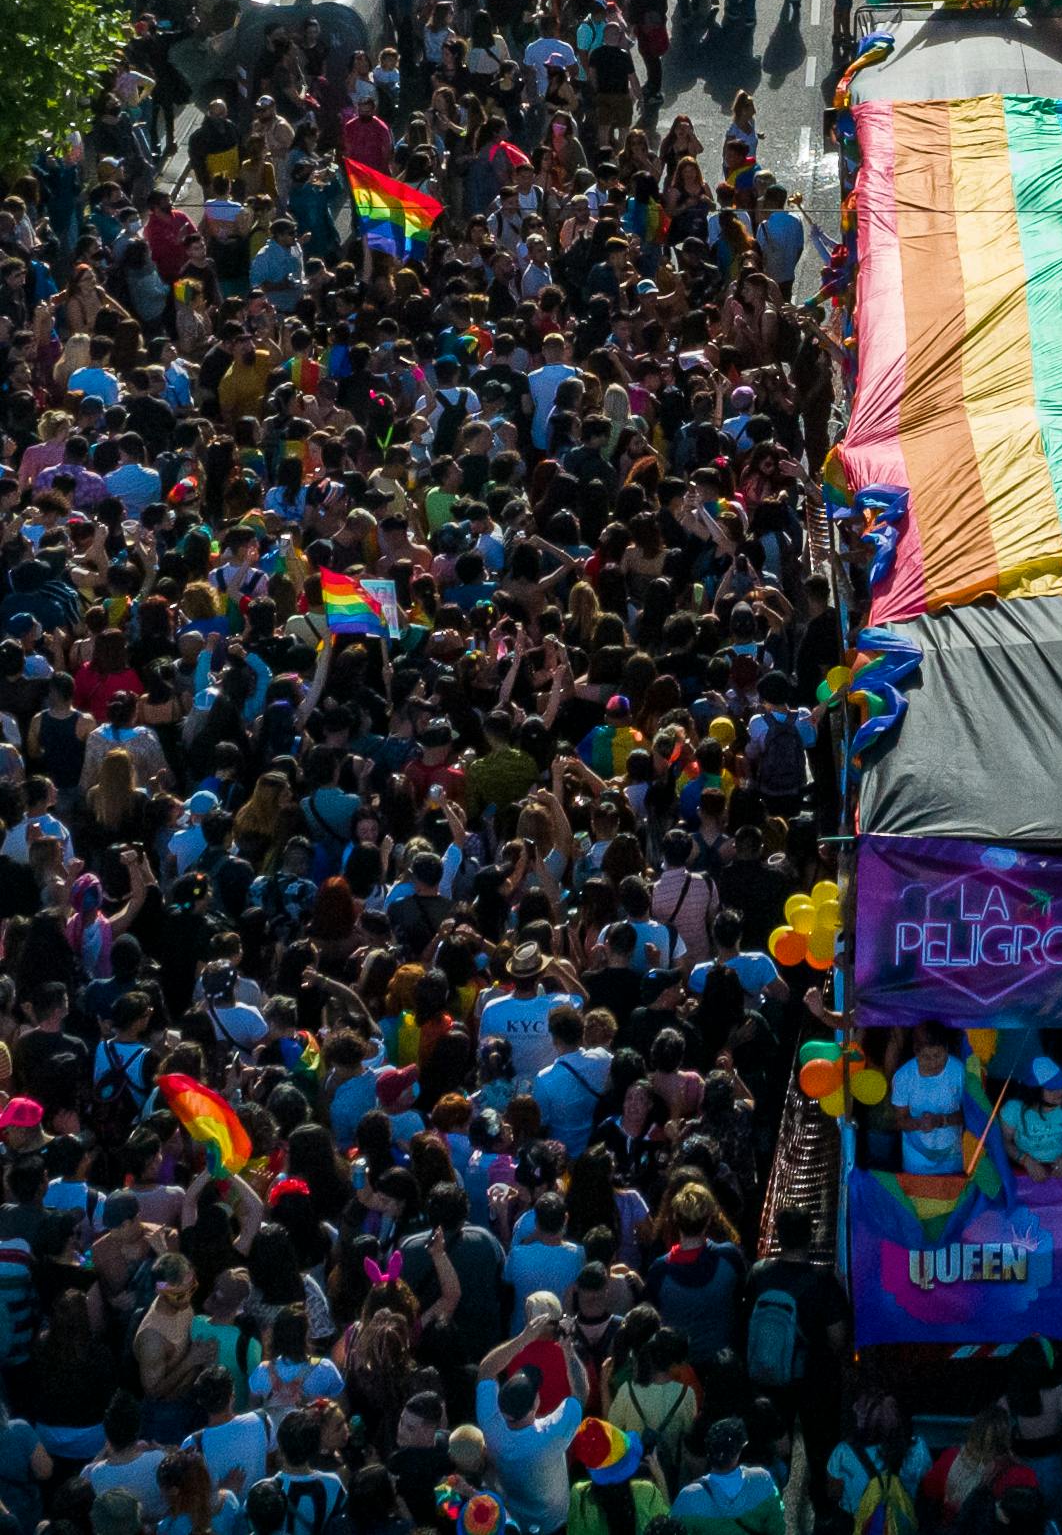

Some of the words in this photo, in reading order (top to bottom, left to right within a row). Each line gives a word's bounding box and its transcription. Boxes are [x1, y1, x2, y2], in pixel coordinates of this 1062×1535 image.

[961, 883, 1010, 921] LA
[507, 1019, 545, 1033] KYC
[908, 1242, 1027, 1290] QUEEN
